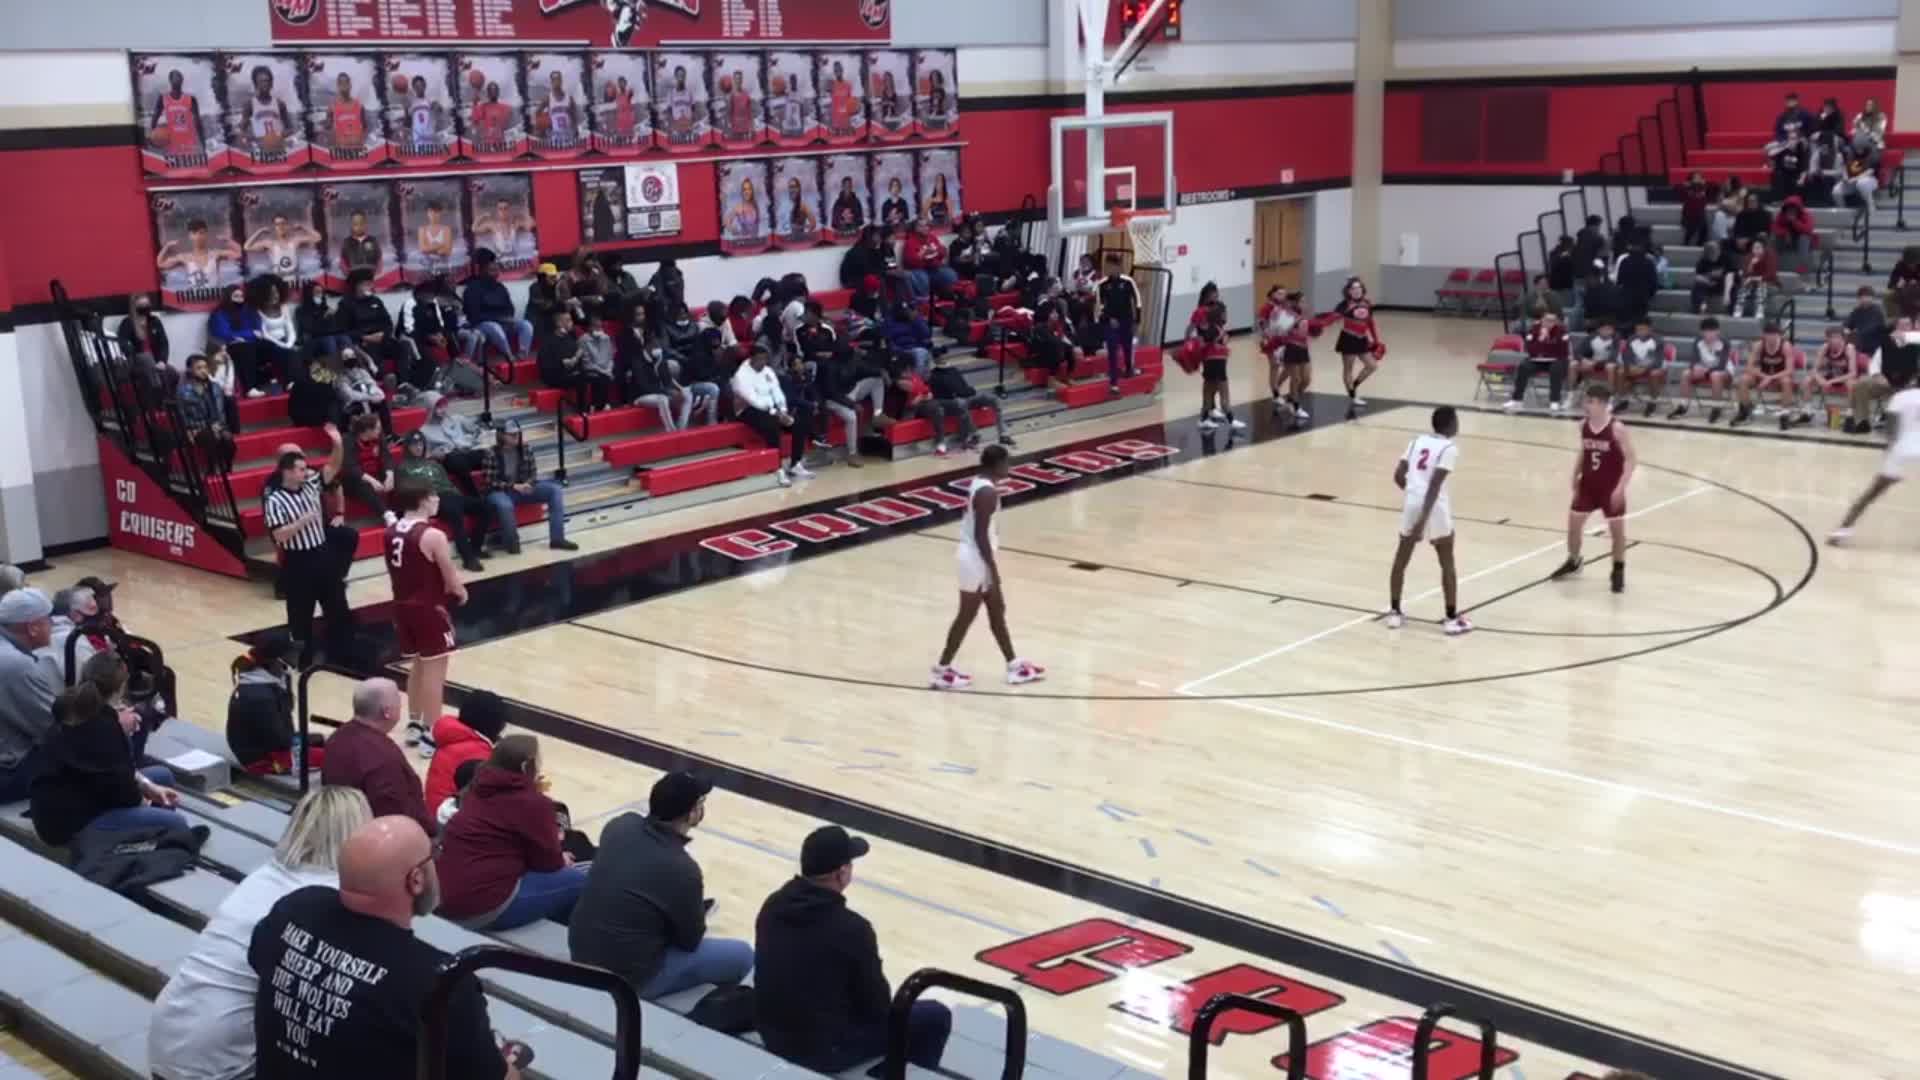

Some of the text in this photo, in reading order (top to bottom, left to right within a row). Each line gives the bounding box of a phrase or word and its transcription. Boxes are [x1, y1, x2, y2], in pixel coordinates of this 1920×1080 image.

[1417, 448, 1430, 470] 2
[1591, 451, 1602, 470] 5
[116, 479, 136, 503] GO
[699, 439, 1180, 561] CRUISERS
[121, 510, 195, 548] CRUISERS
[391, 537, 404, 568] 3
[280, 921, 388, 986] MAKE YOURSELF
[281, 947, 354, 996] SHEEP AND
[272, 965, 352, 1019] THE WOLVES
[273, 991, 335, 1037] WILL EAT
[285, 1020, 311, 1048] YOU
